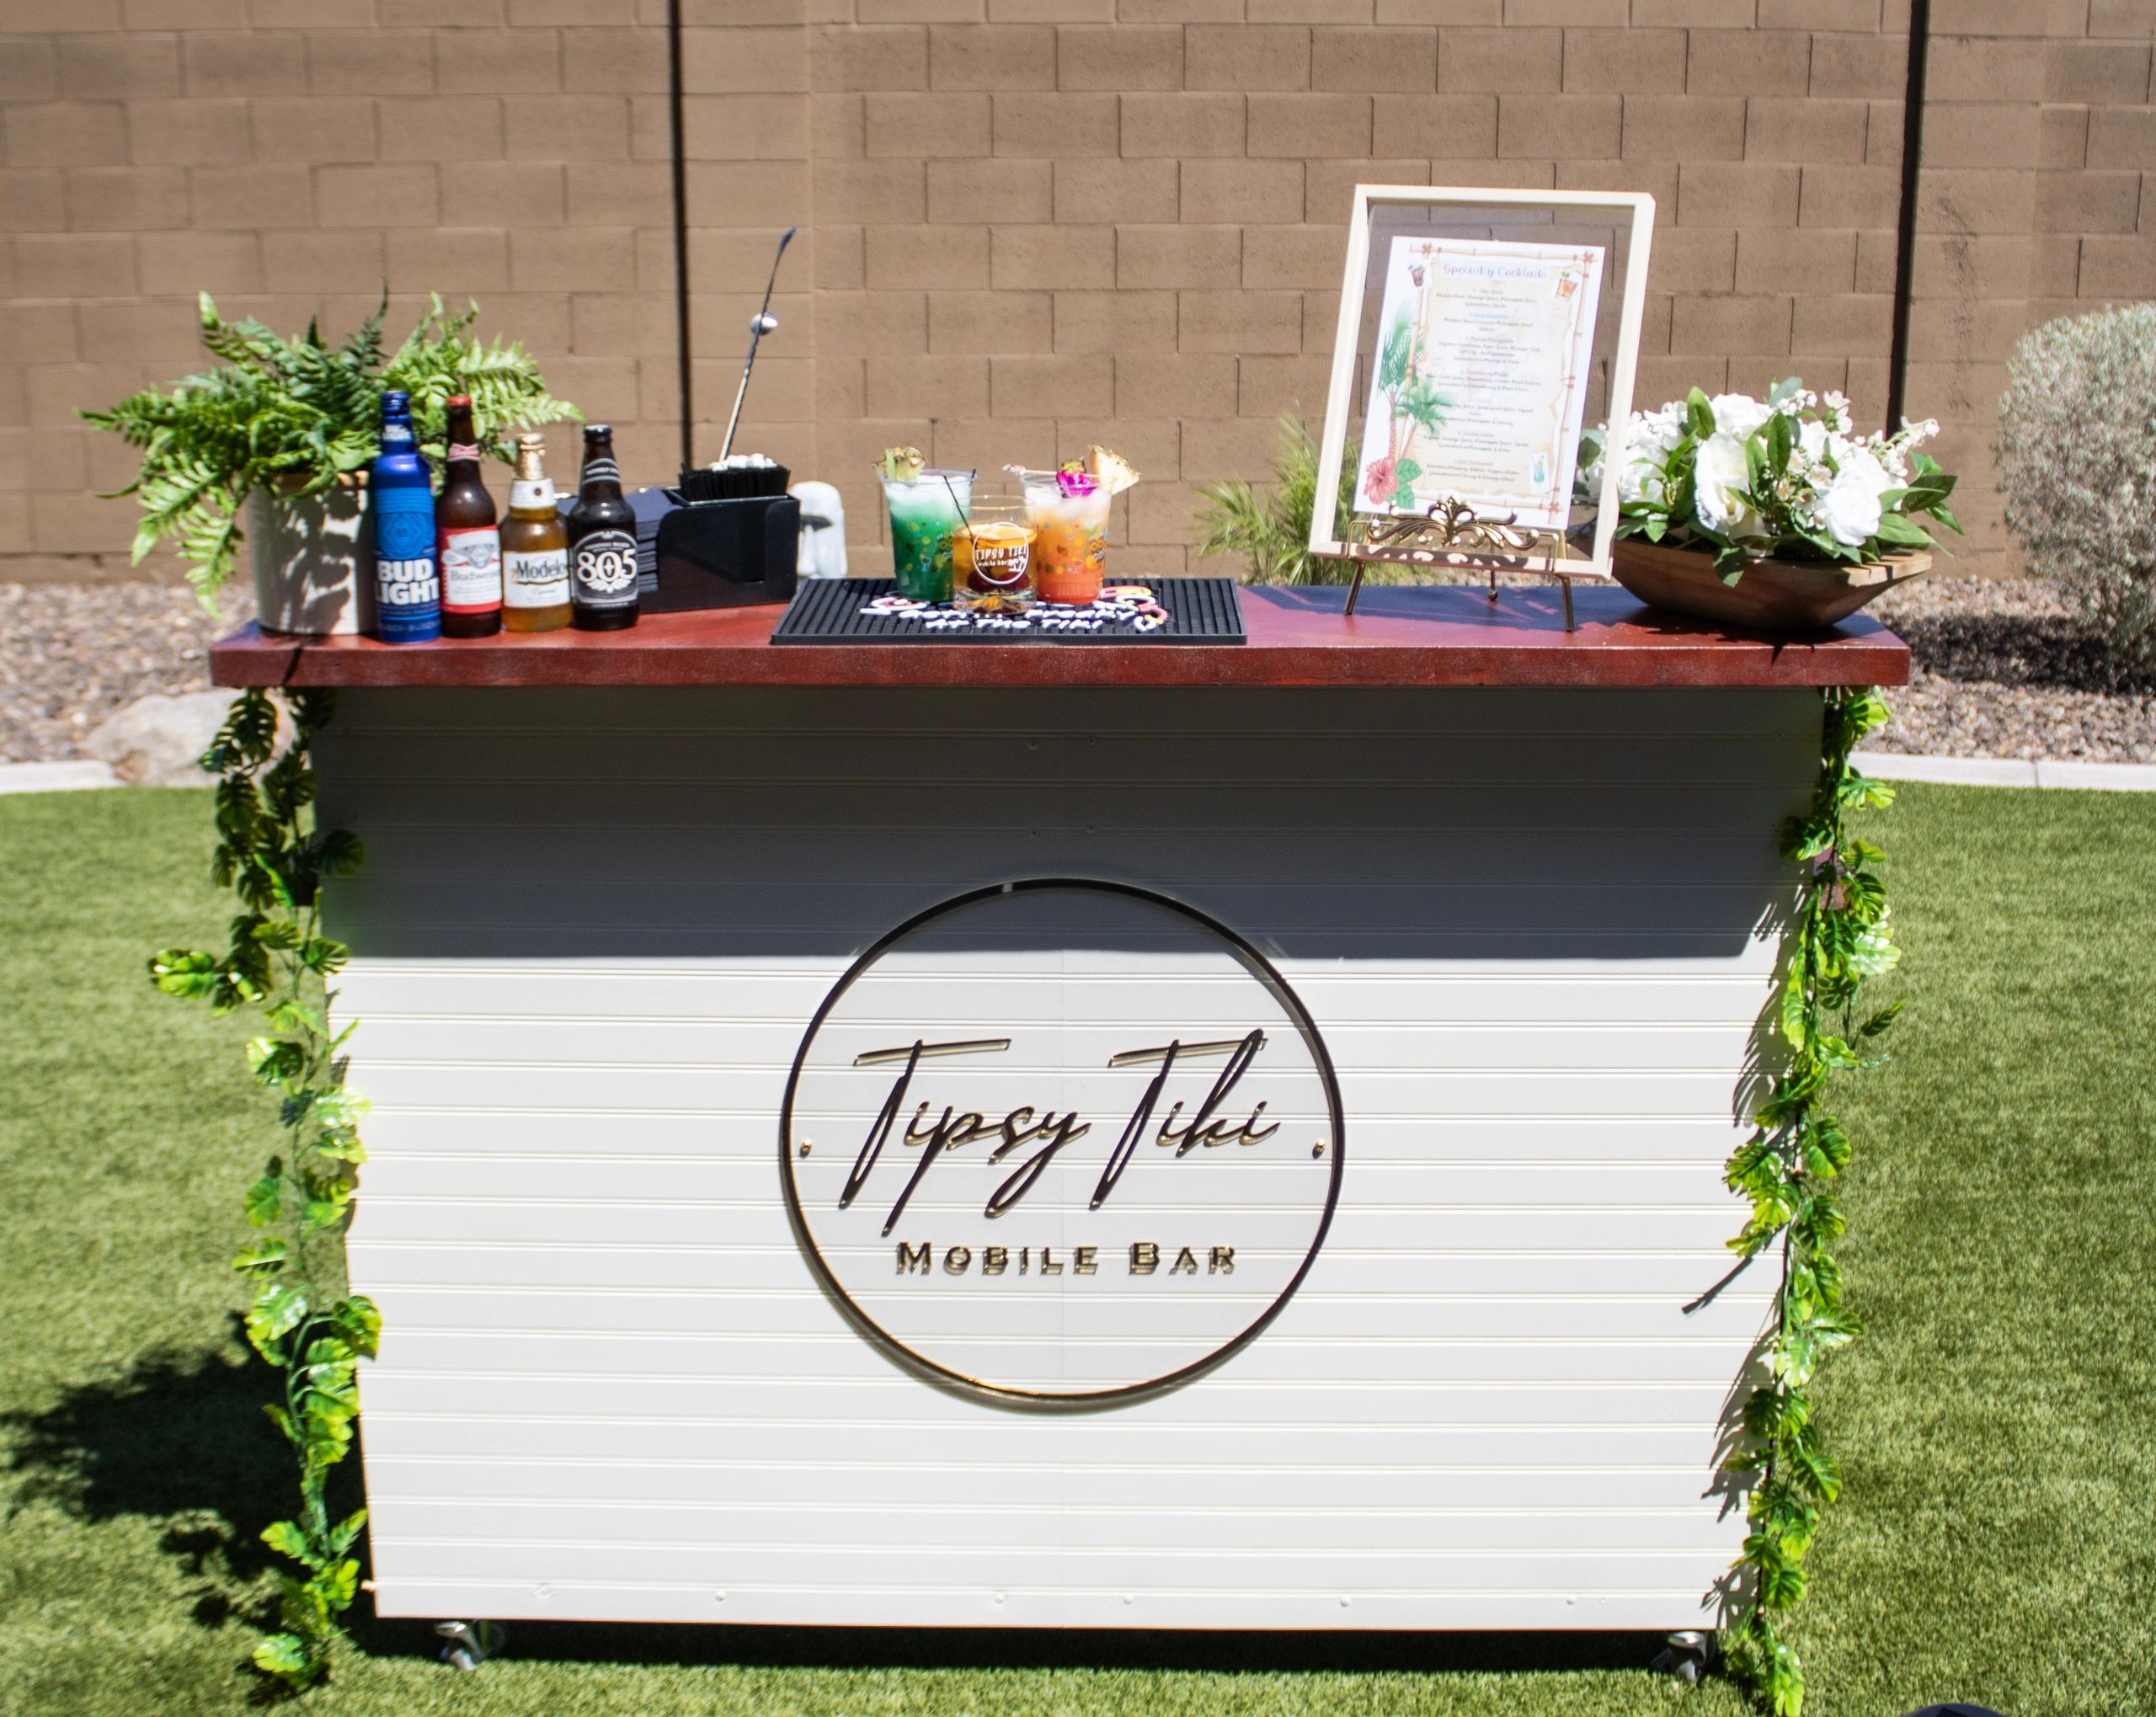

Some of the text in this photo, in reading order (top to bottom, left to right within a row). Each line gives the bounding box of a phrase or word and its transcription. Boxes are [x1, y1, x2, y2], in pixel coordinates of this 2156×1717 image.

[1497, 265, 1546, 279] Cocktails
[577, 548, 638, 582] 805
[975, 545, 1027, 560] TIPSY TIKI
[377, 558, 434, 583] BUD
[838, 1029, 1281, 1237] Tipsy Tiki
[895, 1240, 1236, 1277] MOBILE BAR
